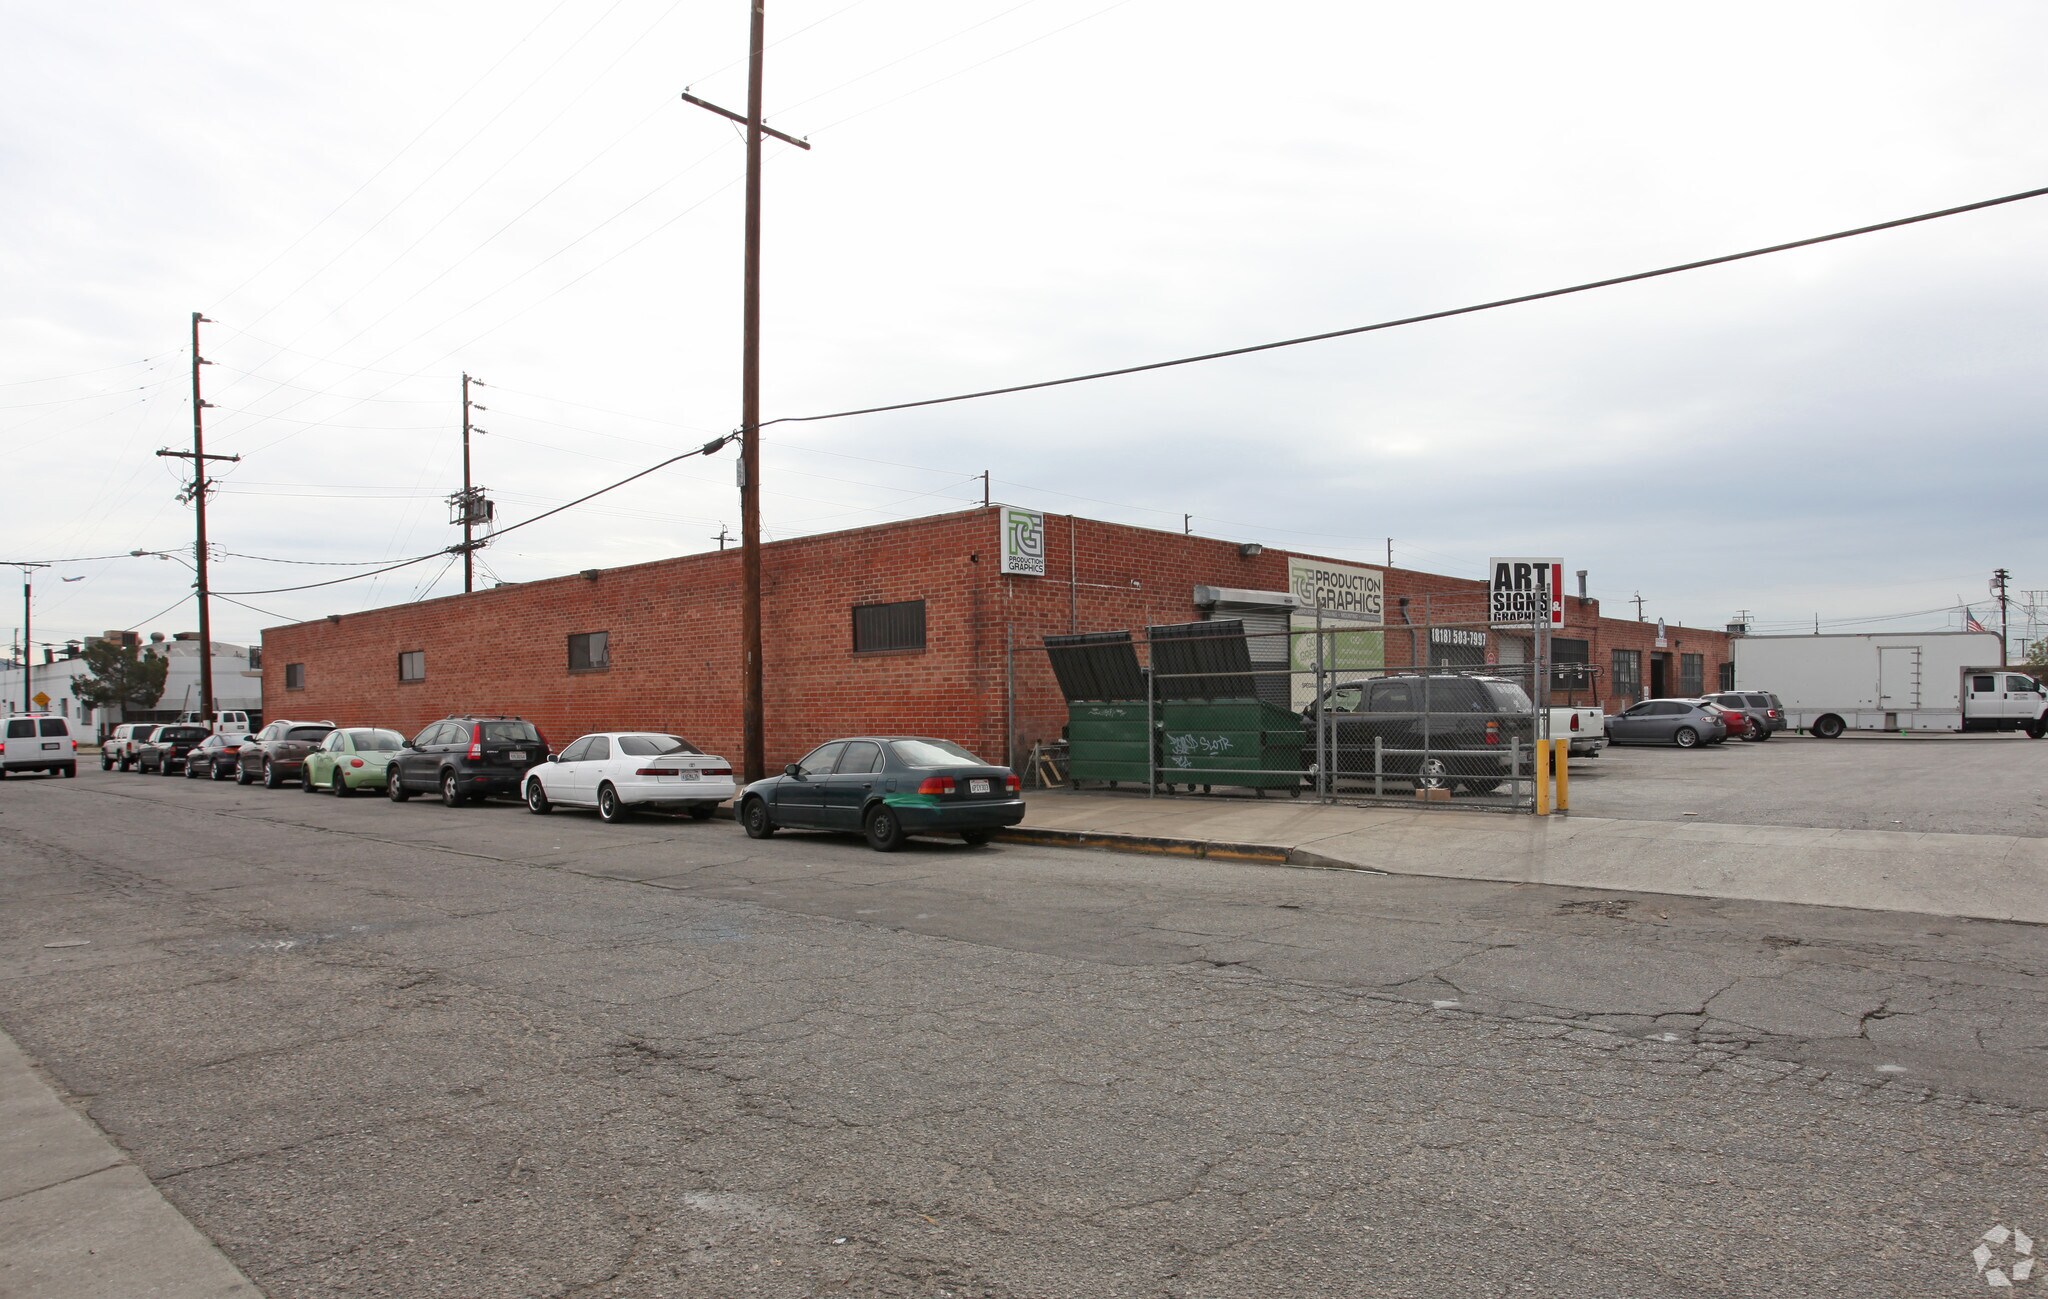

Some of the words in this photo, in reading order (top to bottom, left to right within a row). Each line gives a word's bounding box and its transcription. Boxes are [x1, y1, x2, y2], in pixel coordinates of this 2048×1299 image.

[1009, 556, 1043, 564] PRODUCTION
[1009, 562, 1043, 573] GRAPHICS
[1316, 570, 1380, 592] PRODUCTION
[1494, 563, 1549, 591] ART
[1316, 587, 1380, 613] GRAPHICS
[1493, 592, 1549, 611] SIGNS
[1432, 628, 1451, 643] (818)
